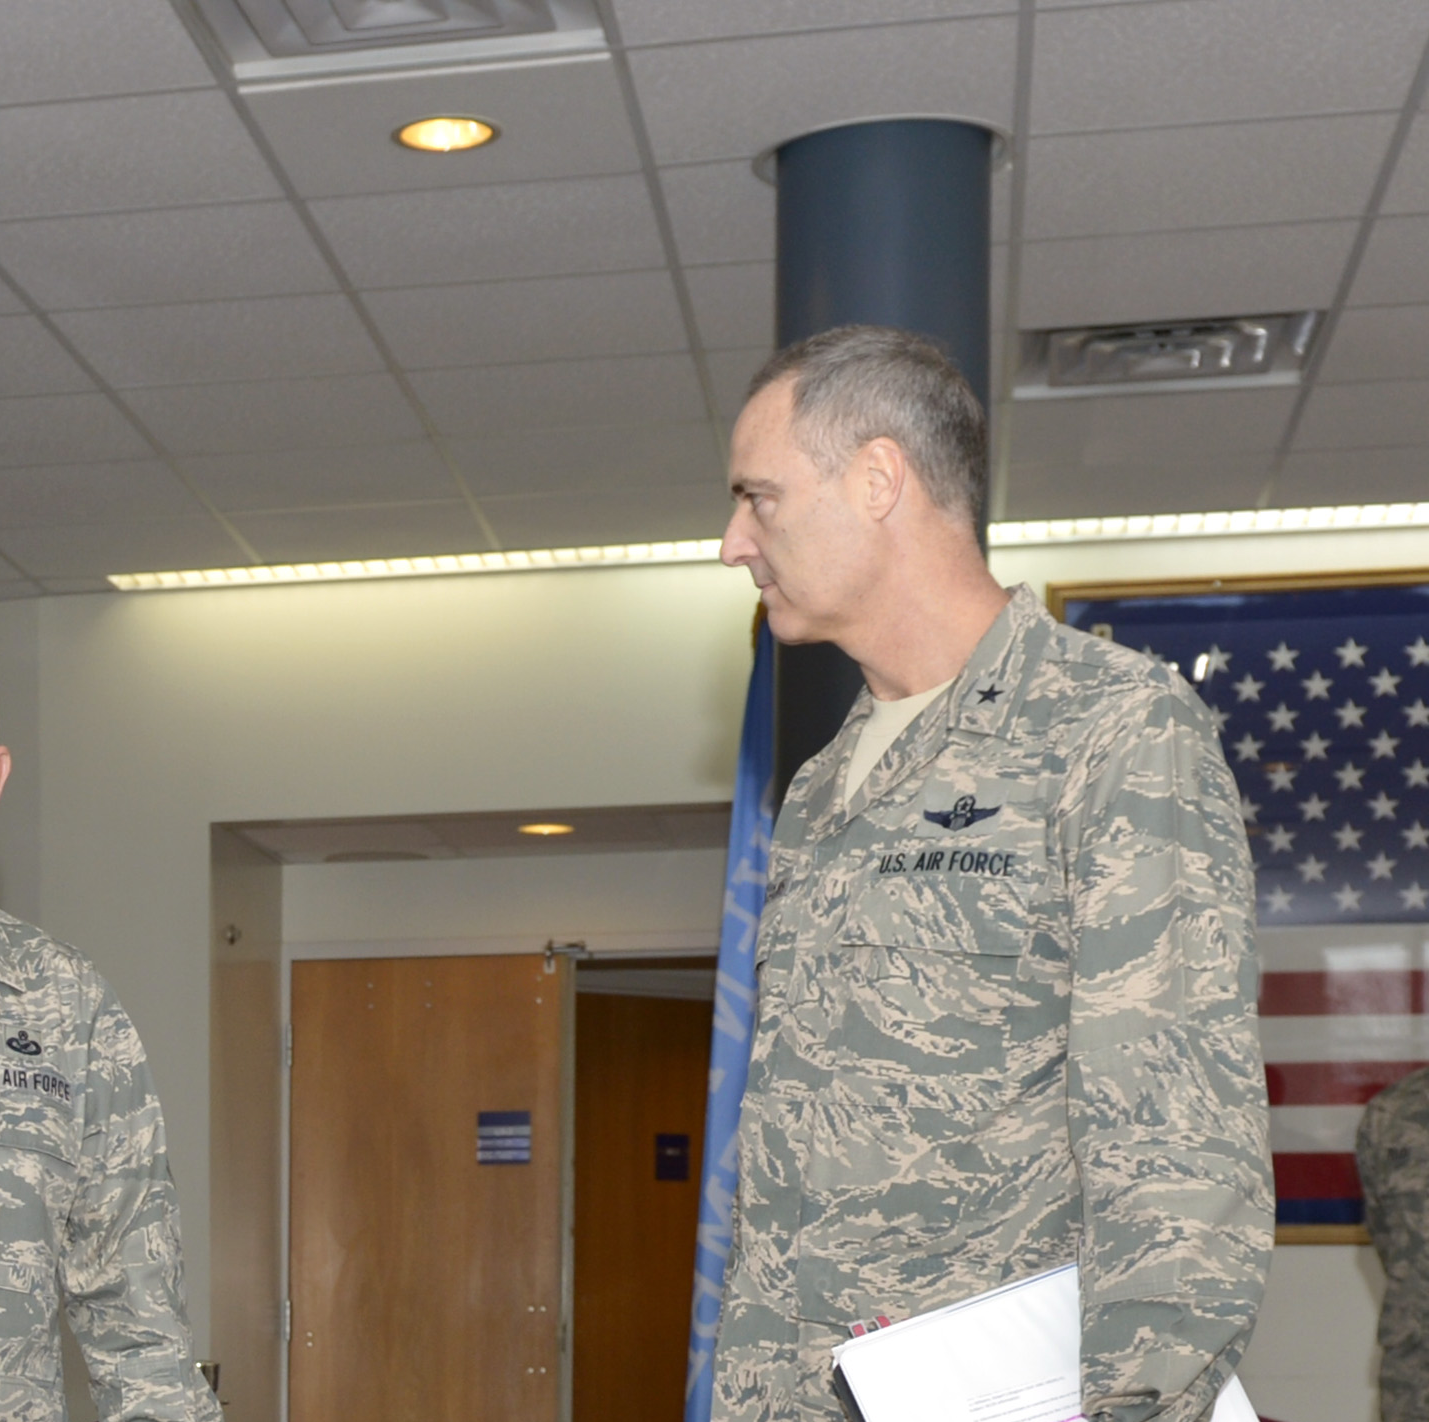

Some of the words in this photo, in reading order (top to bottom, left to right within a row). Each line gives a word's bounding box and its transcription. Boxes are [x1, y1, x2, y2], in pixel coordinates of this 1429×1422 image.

[878, 853, 909, 876] U.S.
[913, 851, 944, 873] AIR
[948, 851, 1016, 878] FORCE
[1, 1068, 29, 1090] AIR
[32, 1072, 72, 1101] FORCE
